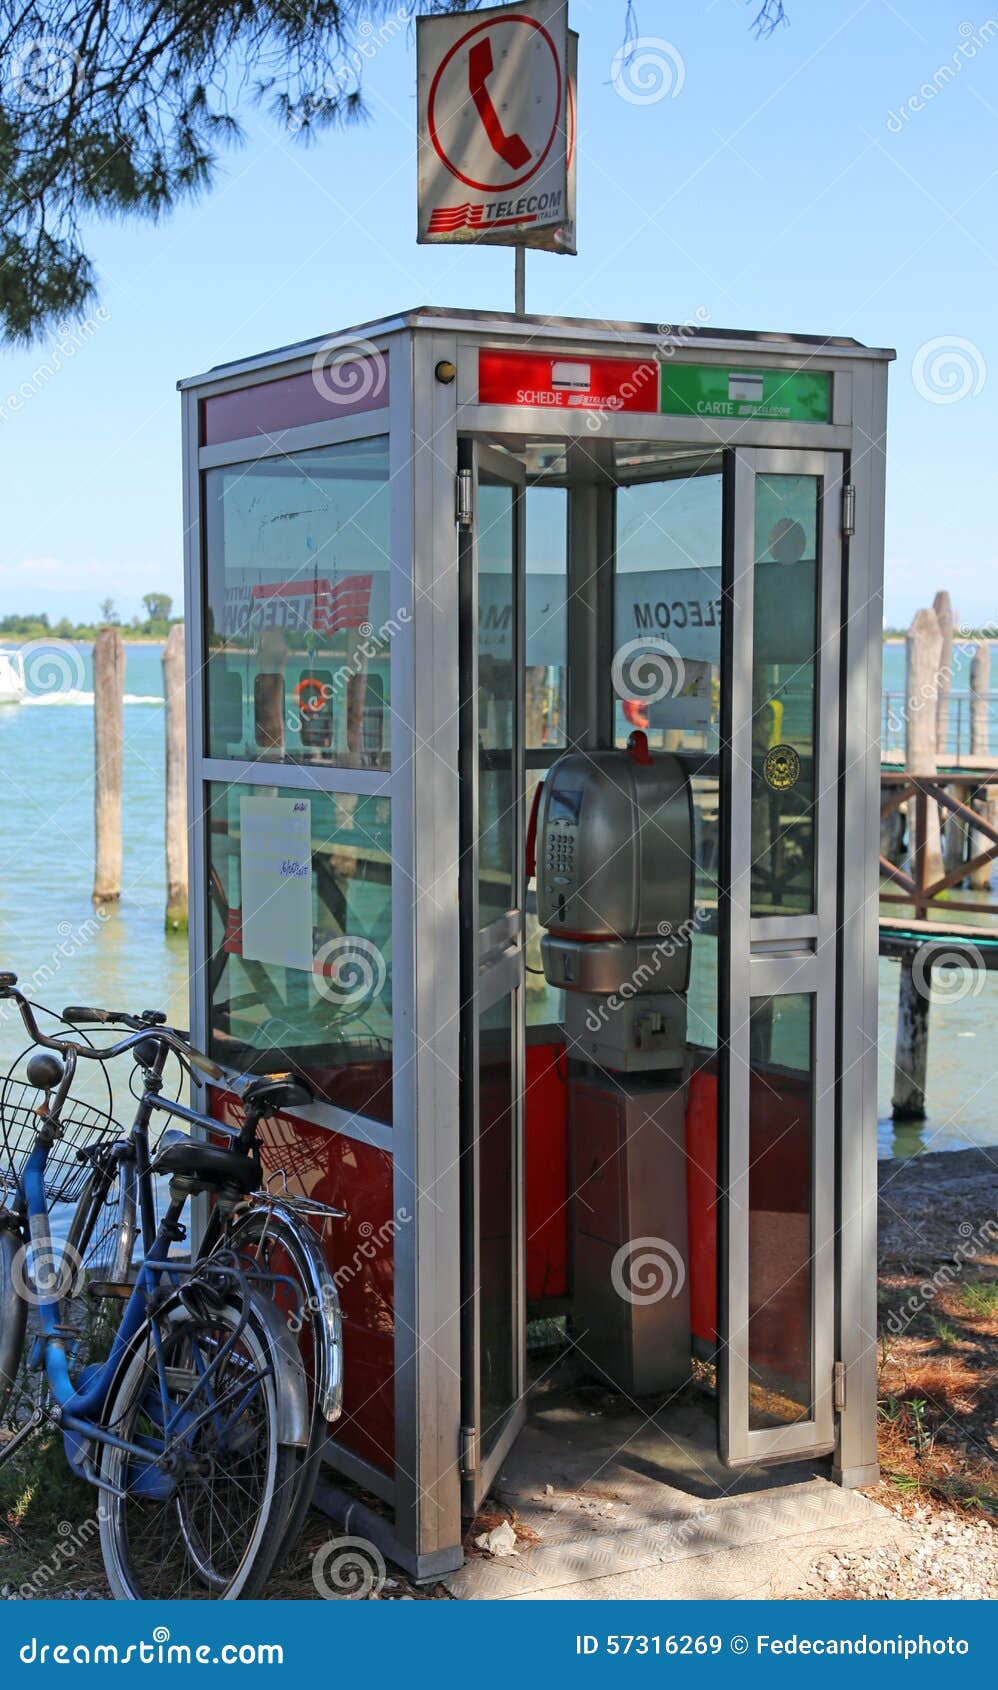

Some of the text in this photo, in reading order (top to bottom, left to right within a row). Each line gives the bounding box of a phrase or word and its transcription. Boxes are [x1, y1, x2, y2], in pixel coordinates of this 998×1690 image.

[486, 190, 561, 219] TELECOM
[516, 390, 562, 405] SCHEDE
[697, 401, 734, 415] CARTE
